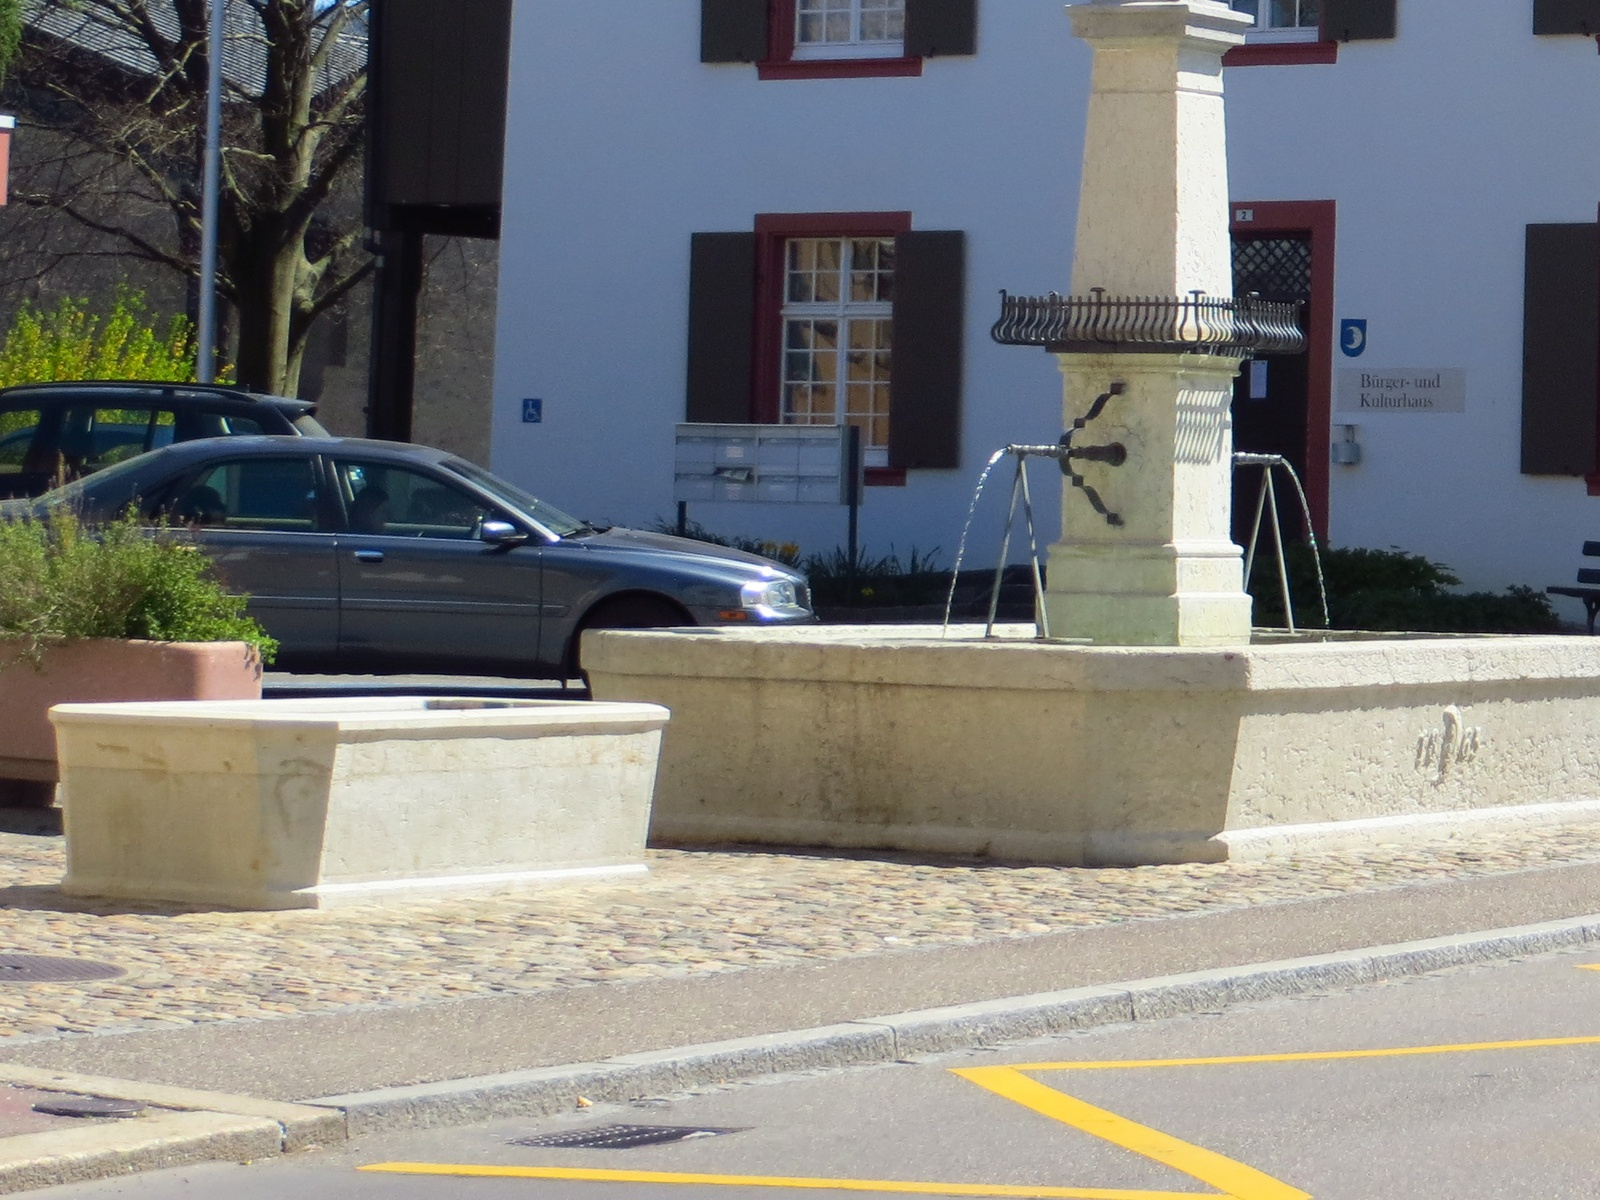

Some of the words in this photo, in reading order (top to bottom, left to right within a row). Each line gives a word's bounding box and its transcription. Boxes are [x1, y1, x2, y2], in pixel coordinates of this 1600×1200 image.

[1360, 373, 1410, 391] Bürger-
[1414, 373, 1441, 389] und
[1360, 393, 1434, 408] Kulturhaus
